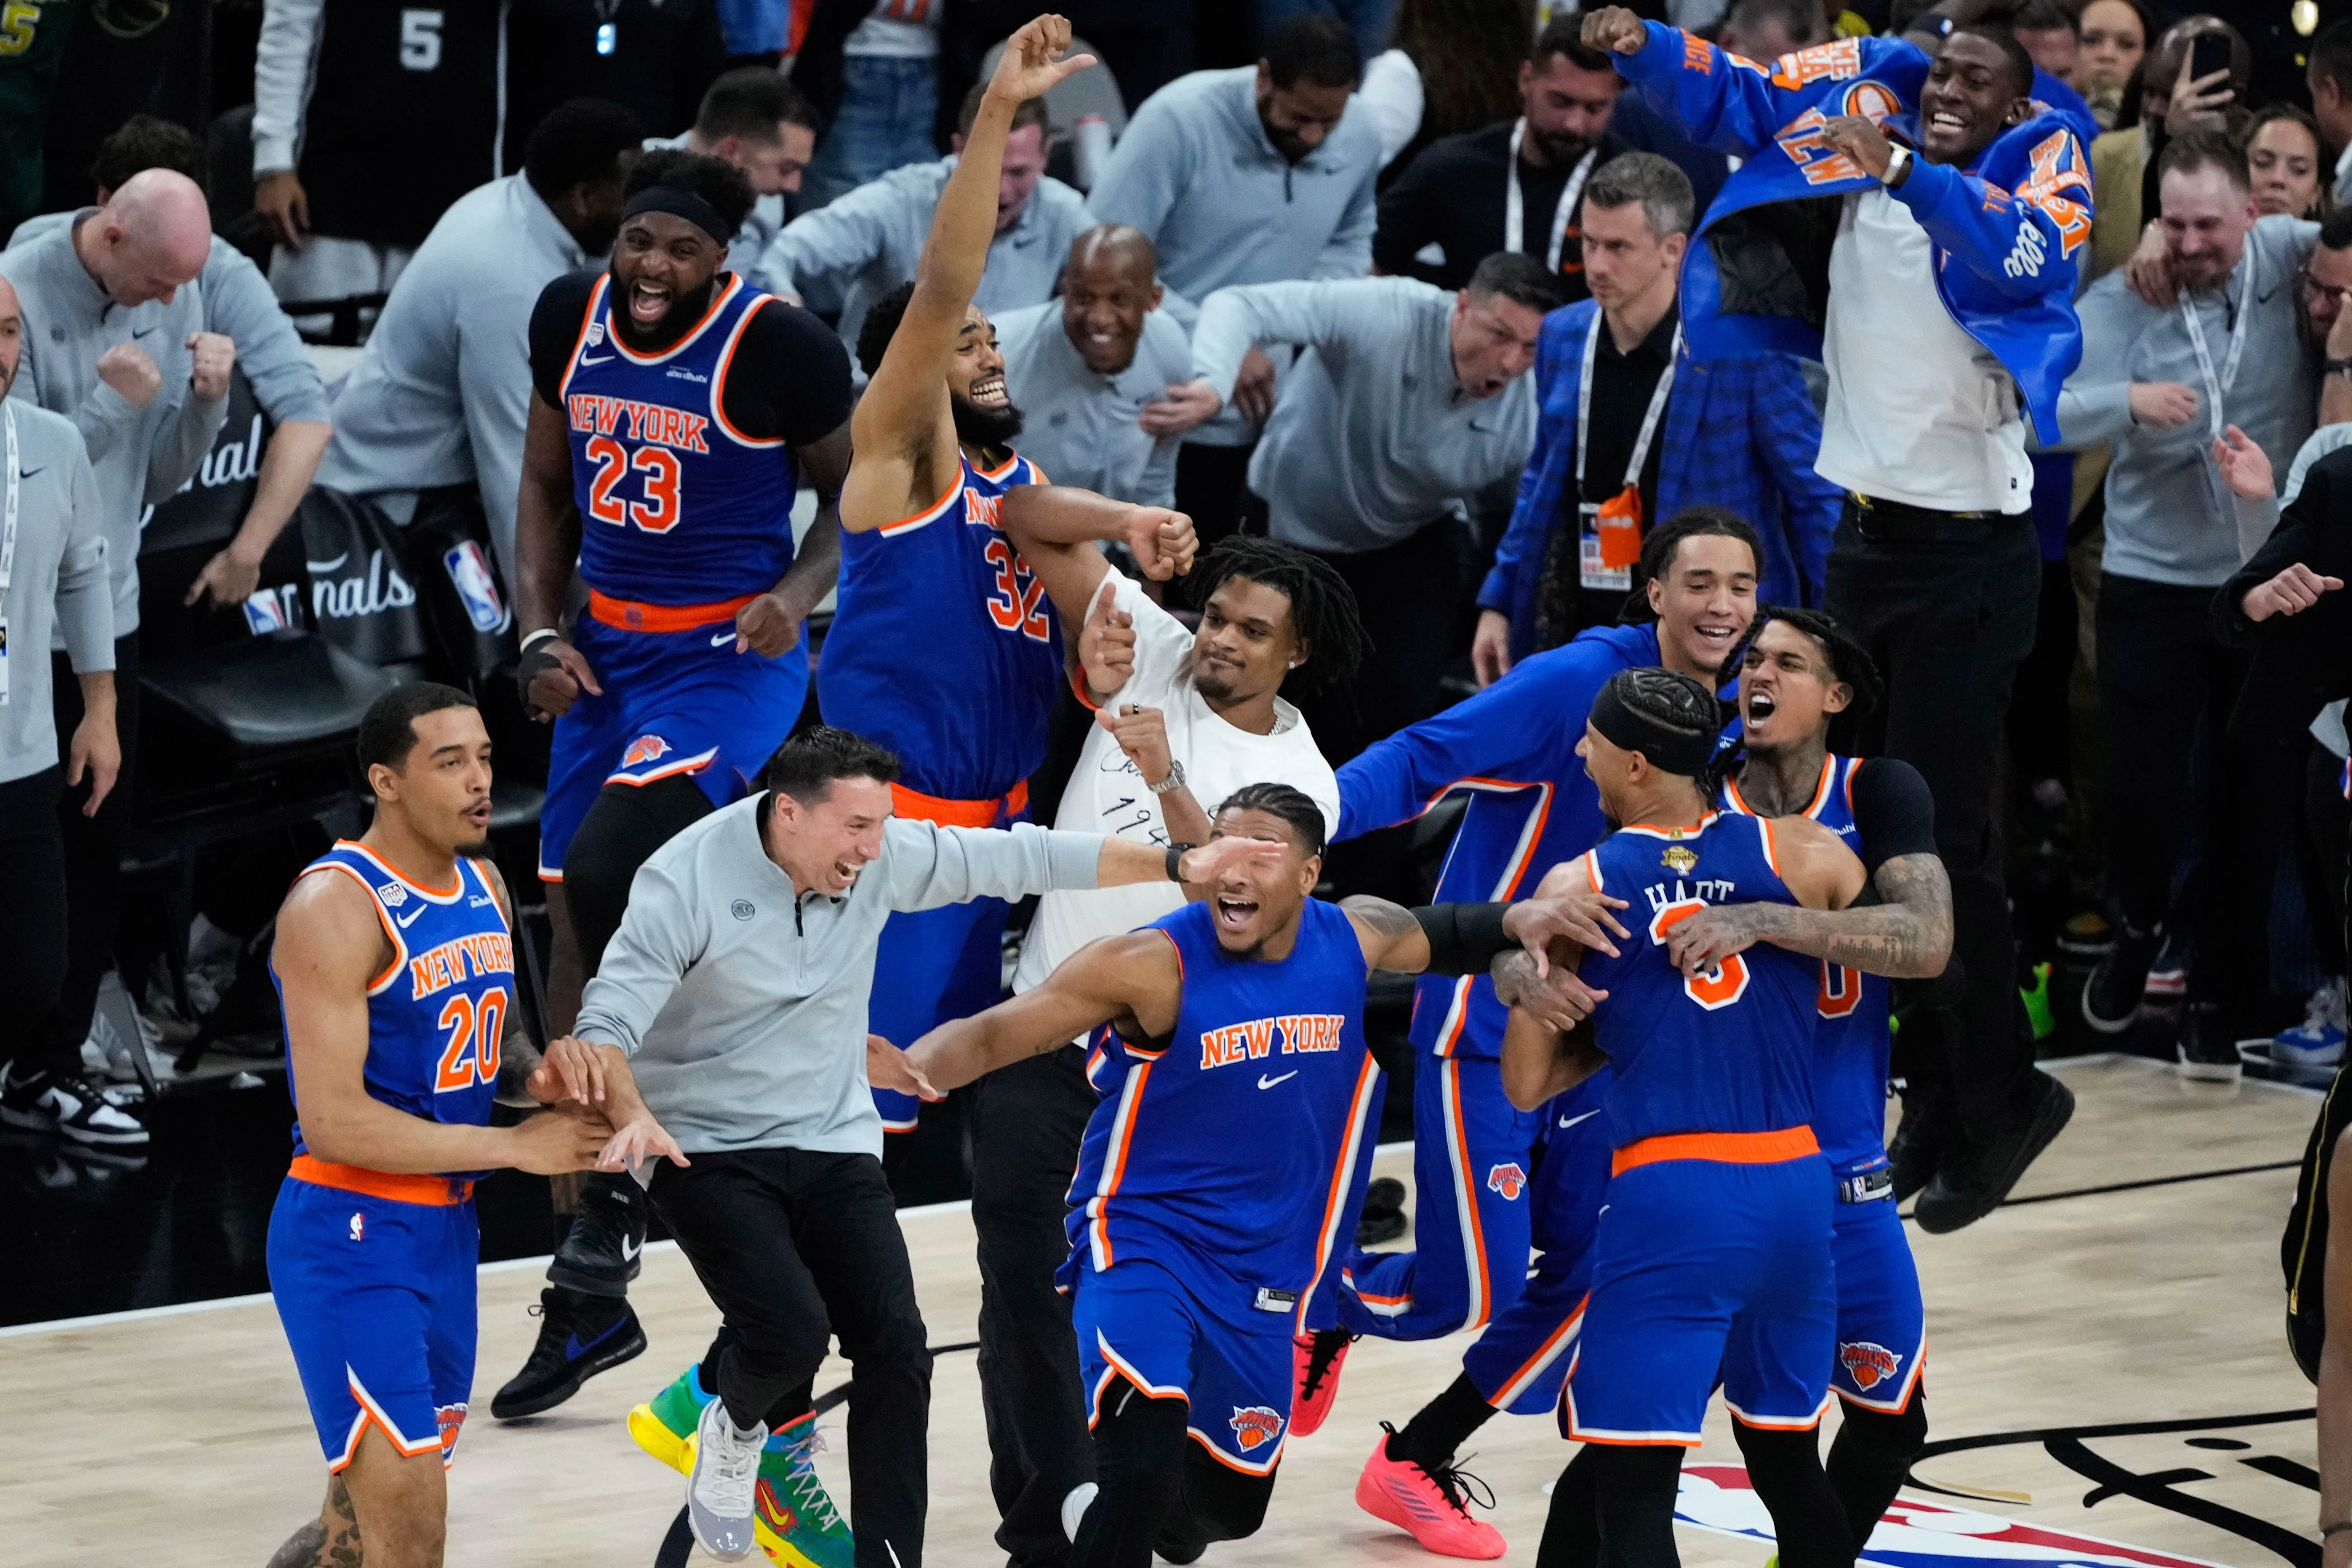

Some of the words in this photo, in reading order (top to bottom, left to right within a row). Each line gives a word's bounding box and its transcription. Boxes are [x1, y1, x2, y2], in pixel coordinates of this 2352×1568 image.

[399, 8, 445, 72] 5
[568, 394, 625, 436] NEW
[626, 401, 710, 455] YORK
[585, 434, 682, 534] 23
[984, 537, 1050, 643] 32
[409, 939, 467, 1002] NEW
[462, 931, 515, 977] YORK
[433, 986, 508, 1094] 20
[1200, 1017, 1275, 1070] NEW
[1276, 1014, 1345, 1055] YORK
